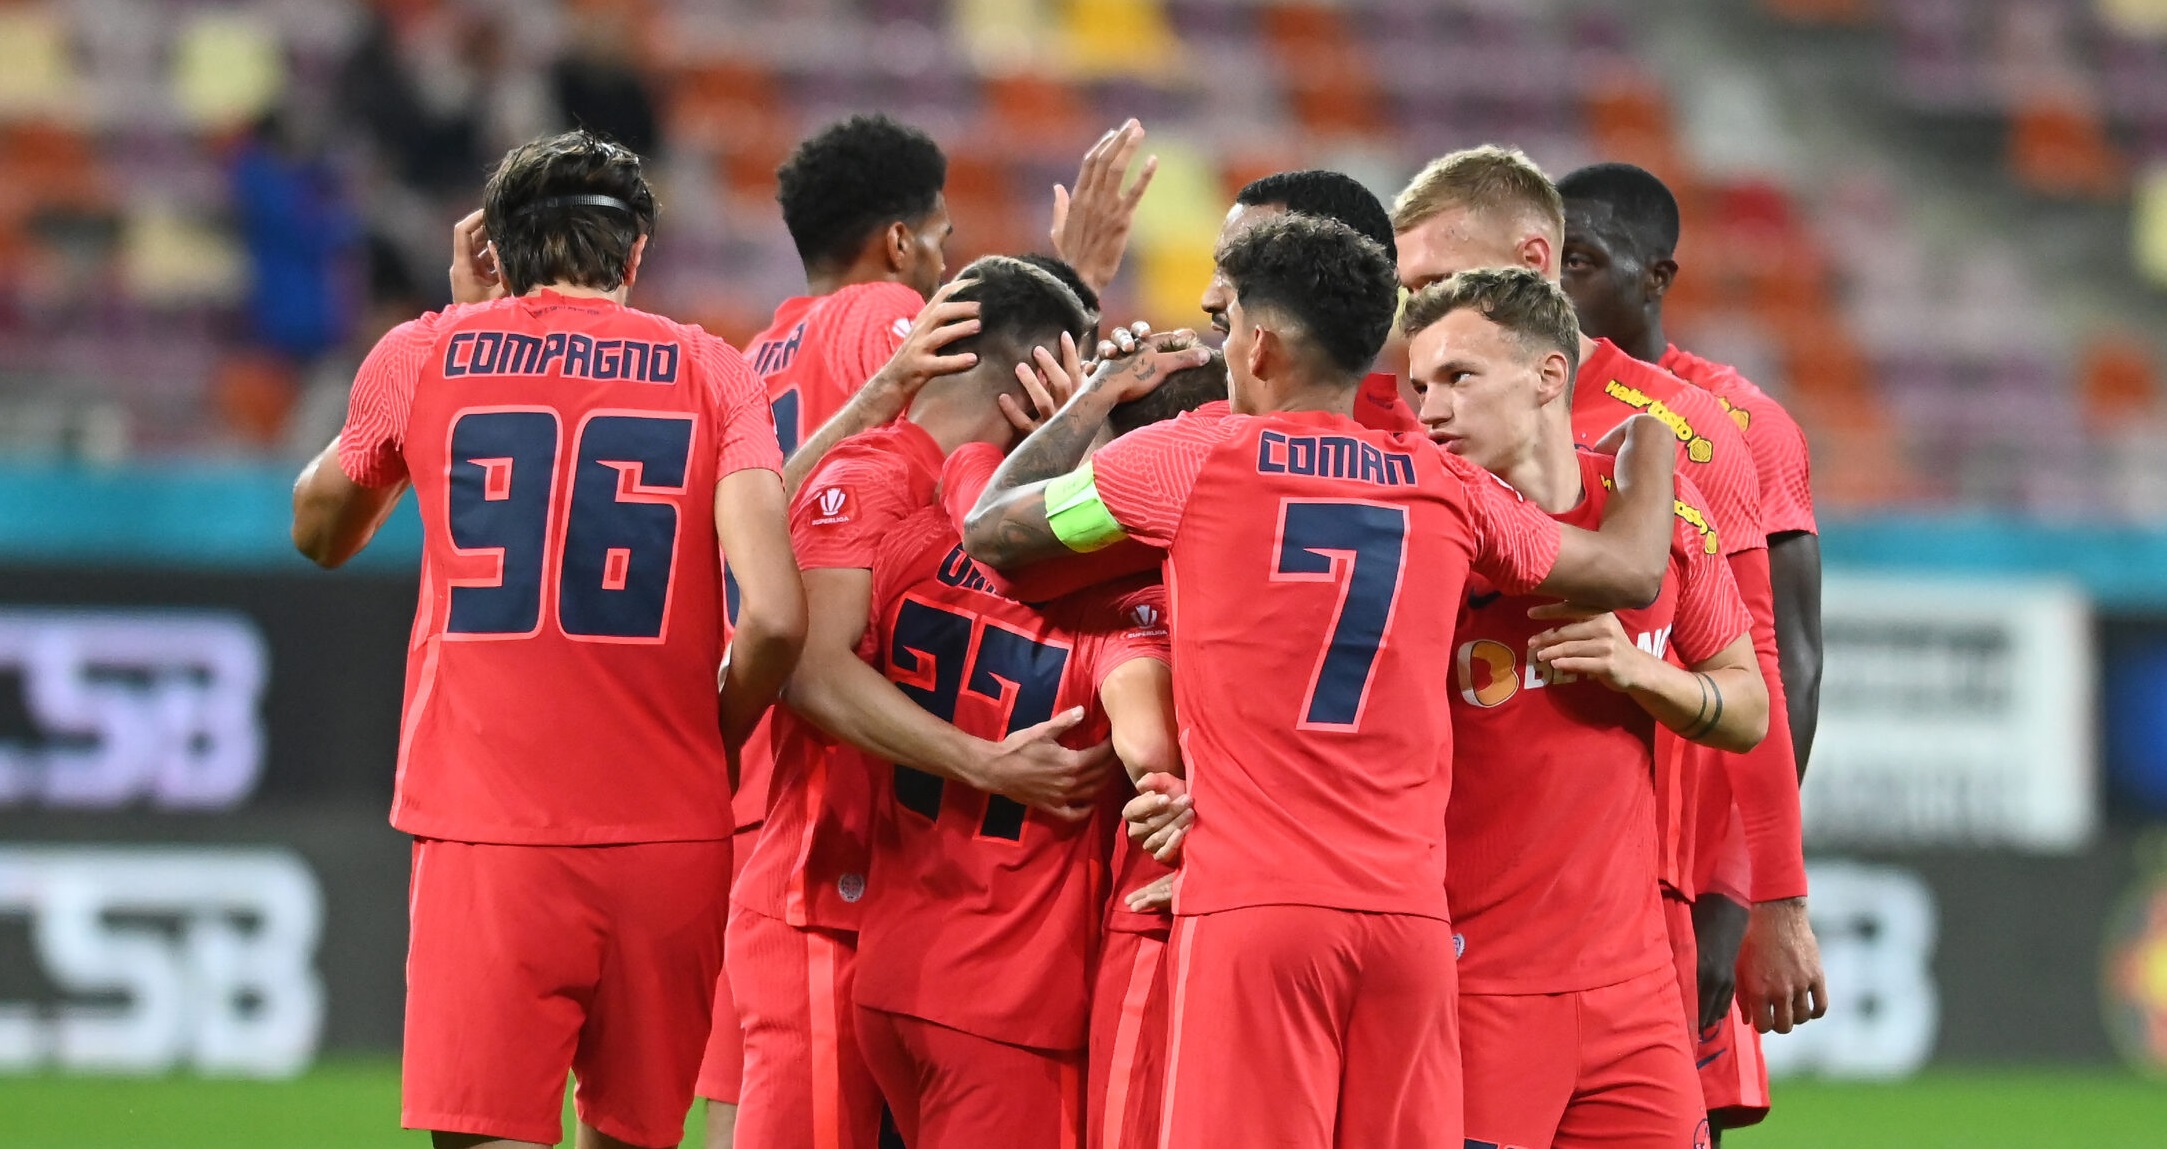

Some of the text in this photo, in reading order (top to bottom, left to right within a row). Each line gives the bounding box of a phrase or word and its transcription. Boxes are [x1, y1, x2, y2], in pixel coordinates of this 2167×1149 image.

[444, 331, 680, 385] COMPAGNO
[442, 404, 699, 645] 96
[1257, 429, 1418, 487] COMAN
[1269, 497, 1411, 734] 7
